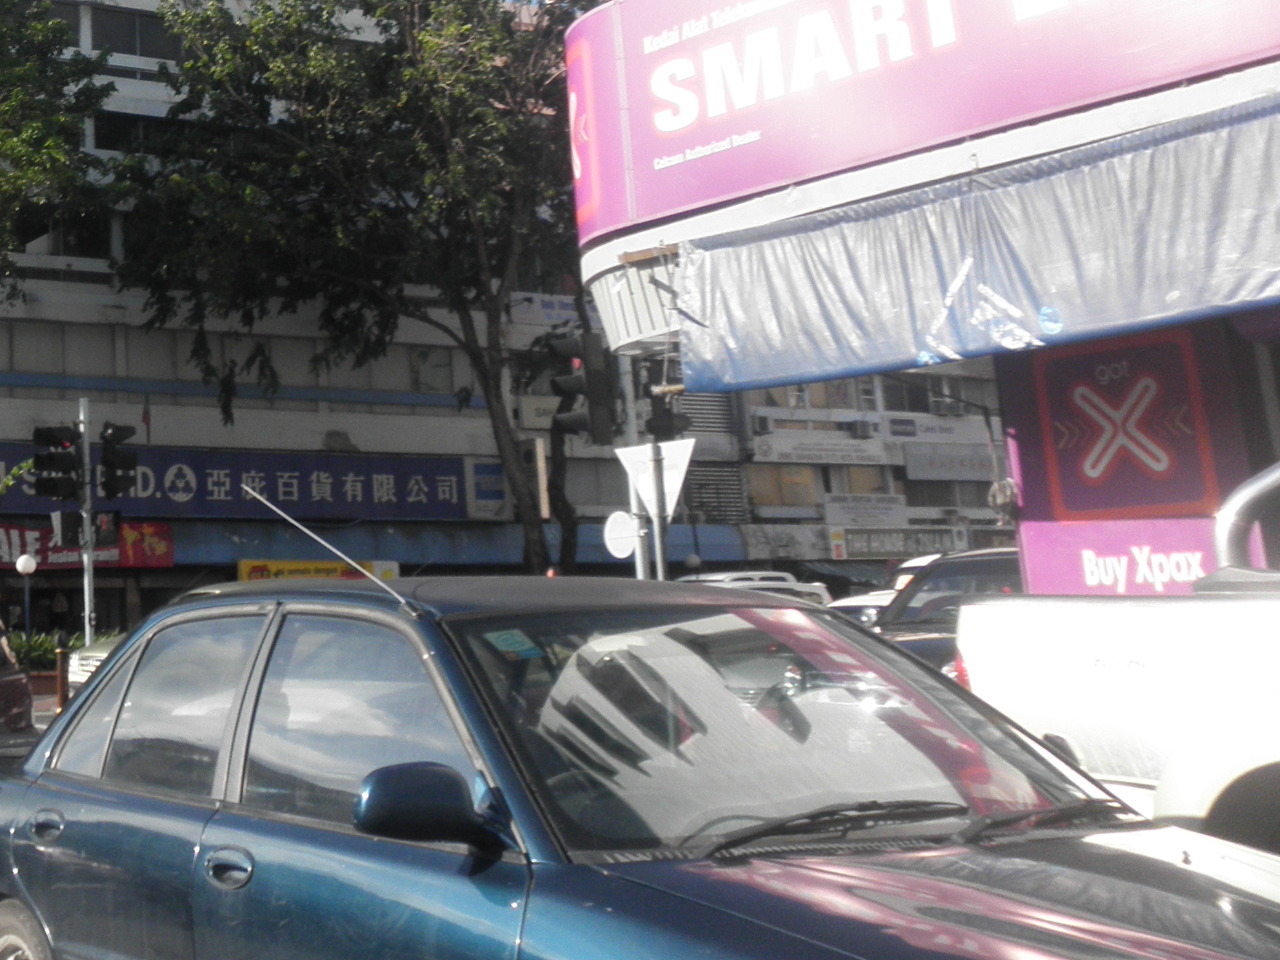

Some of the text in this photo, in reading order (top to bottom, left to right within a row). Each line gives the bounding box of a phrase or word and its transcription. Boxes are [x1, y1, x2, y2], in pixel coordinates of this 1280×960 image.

[643, 25, 680, 55] Kedai
[681, 15, 711, 41] Alat
[1094, 359, 1130, 385] got
[205, 469, 458, 504] 亞庇百貨有限公司
[1081, 545, 1206, 593] Buy Xpax
